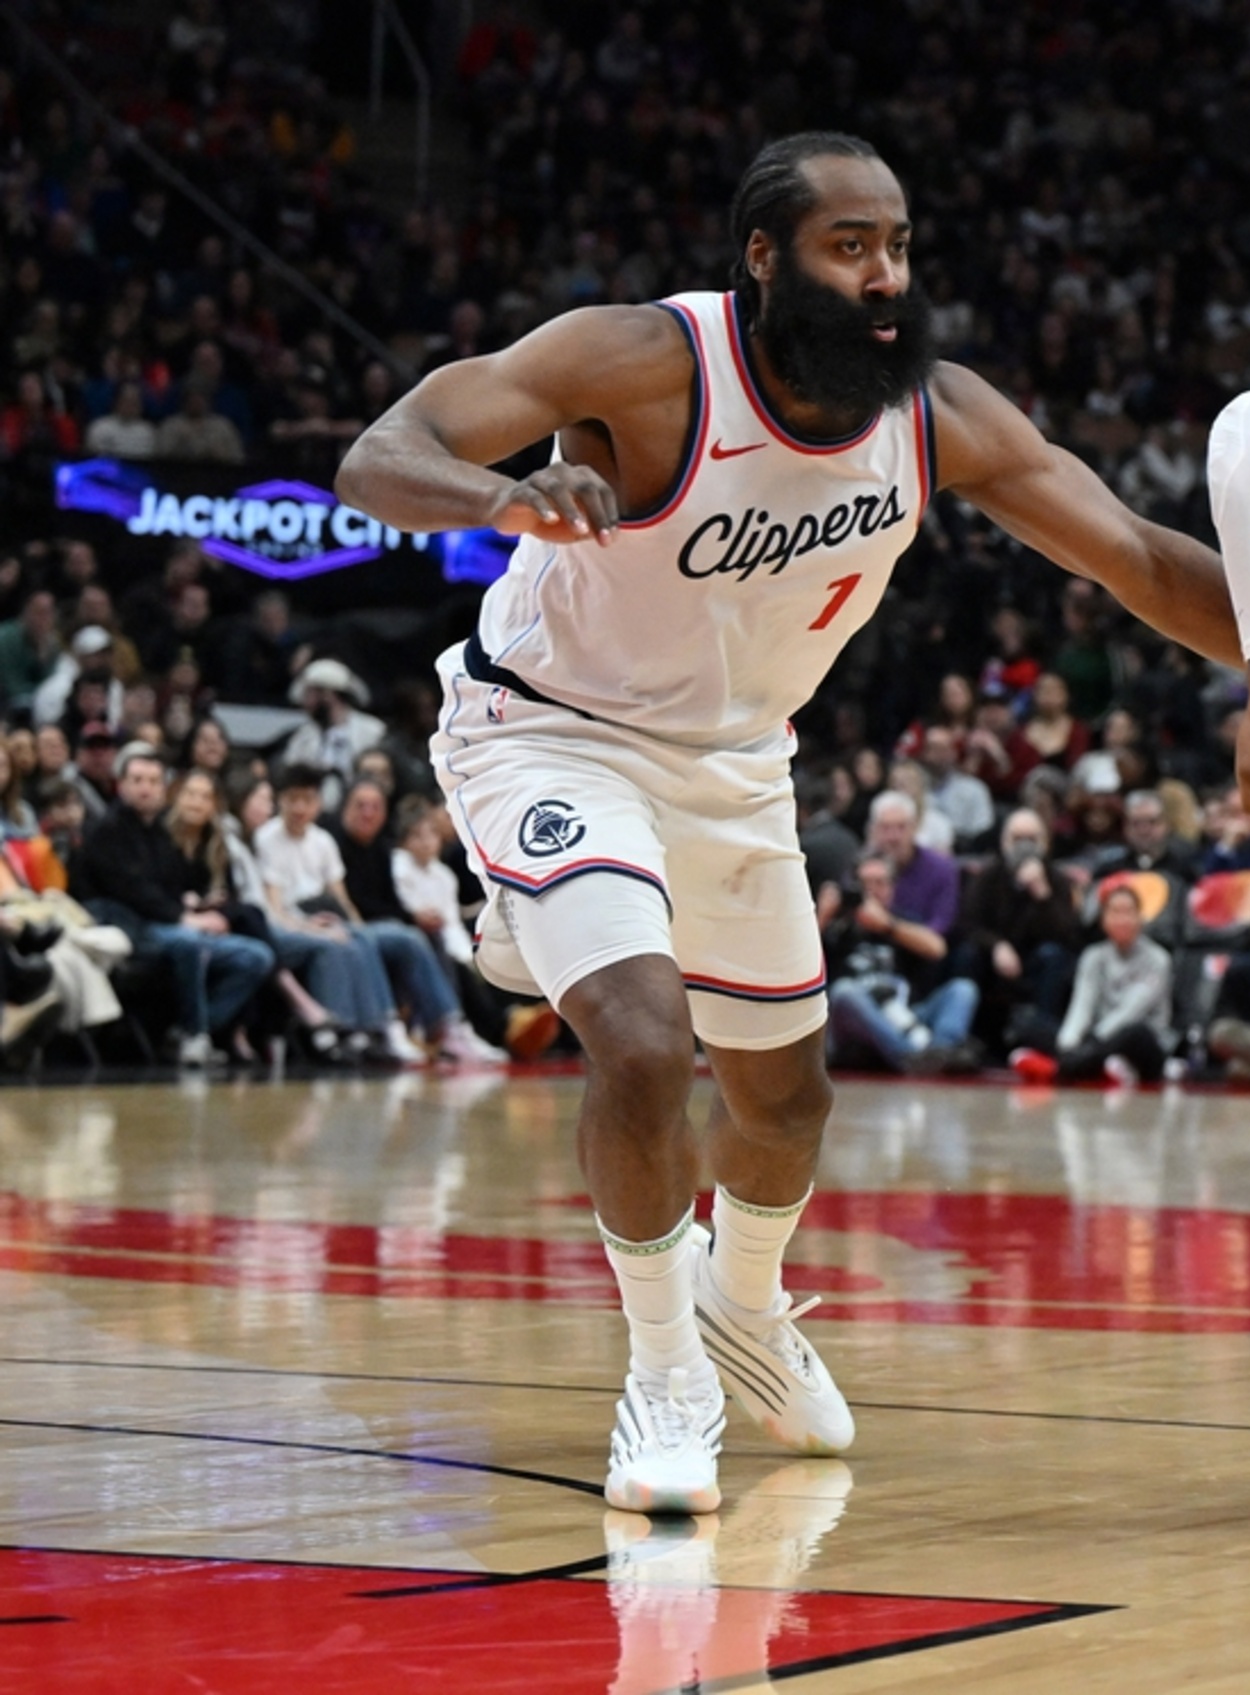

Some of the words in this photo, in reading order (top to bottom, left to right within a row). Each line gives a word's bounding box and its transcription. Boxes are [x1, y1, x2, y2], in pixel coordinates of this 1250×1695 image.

[127, 487, 329, 544] JACKPOT
[330, 503, 429, 552] CI
[677, 485, 907, 583] Clippers
[807, 572, 863, 631] 1
